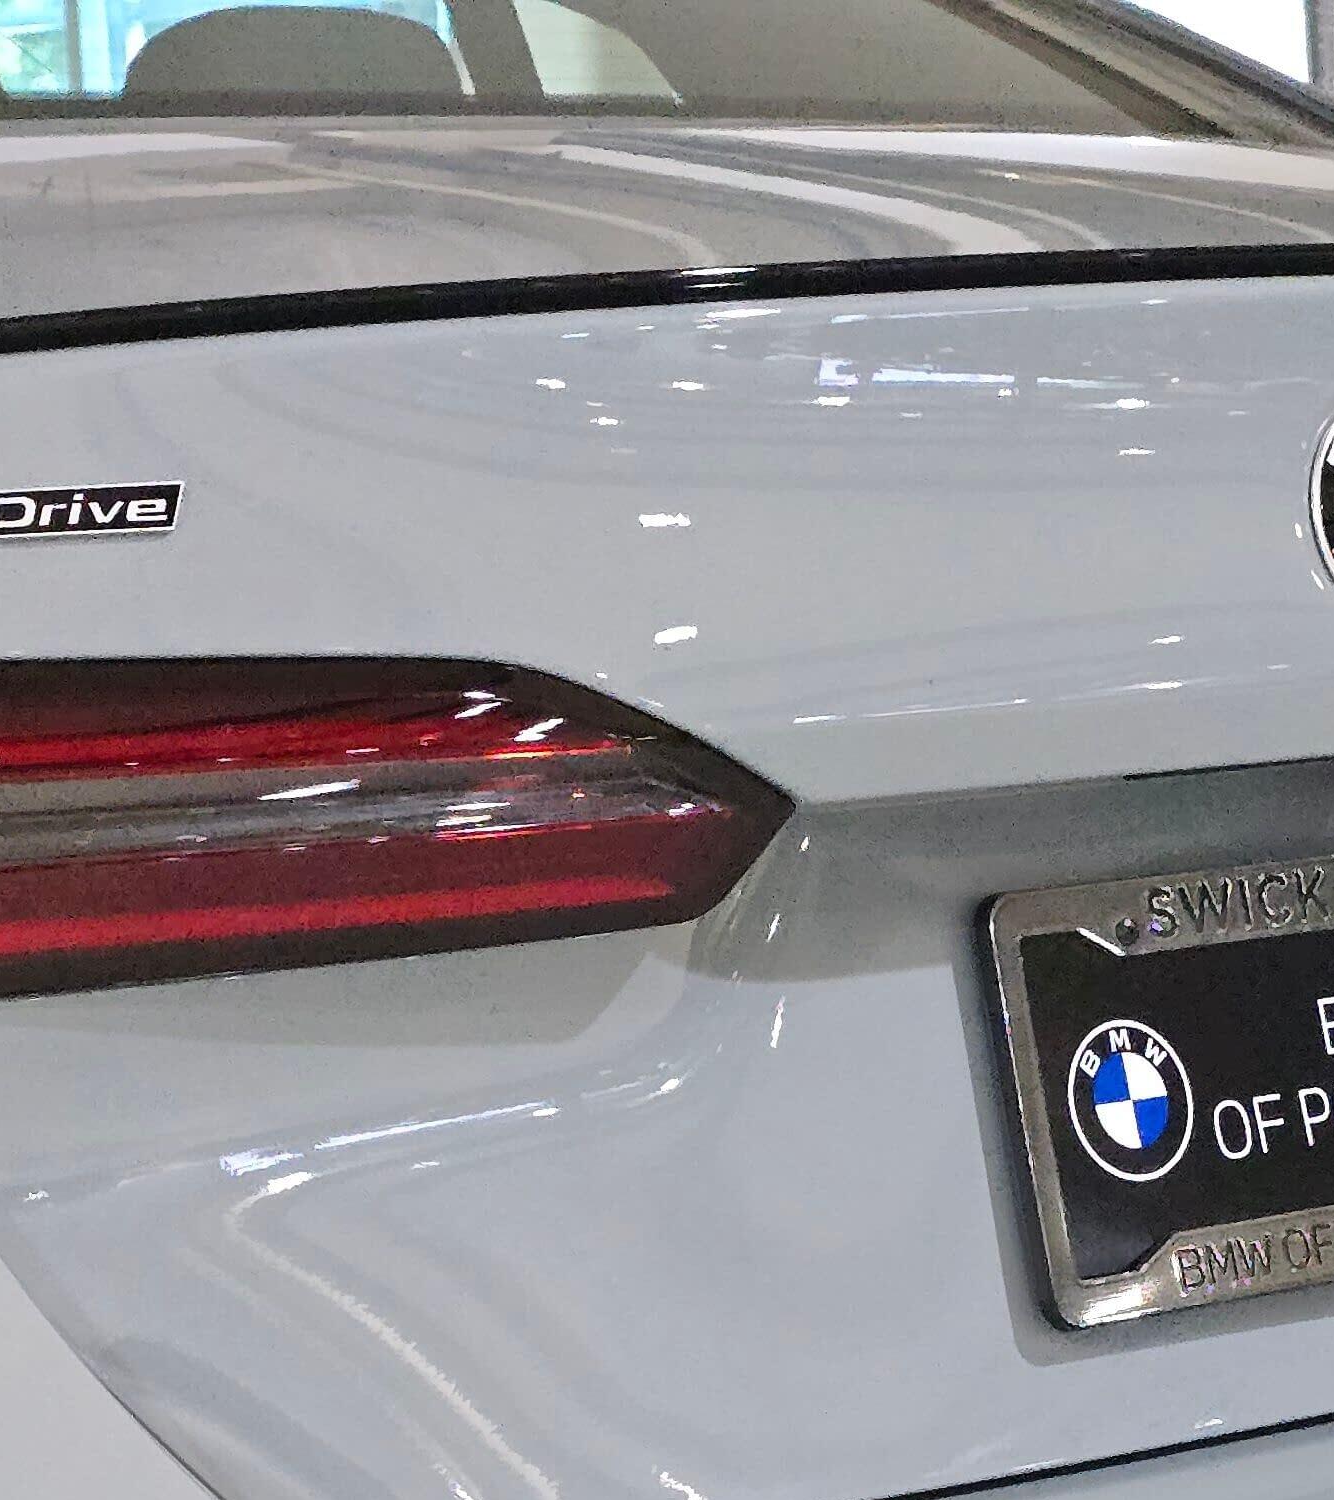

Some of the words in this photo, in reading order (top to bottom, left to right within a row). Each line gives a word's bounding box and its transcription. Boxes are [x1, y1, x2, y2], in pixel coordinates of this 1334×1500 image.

[1079, 1027, 1168, 1077] BMW
[1212, 1092, 1285, 1161] OF
[1174, 1235, 1275, 1295] BMW
[1284, 1224, 1333, 1270] OF
